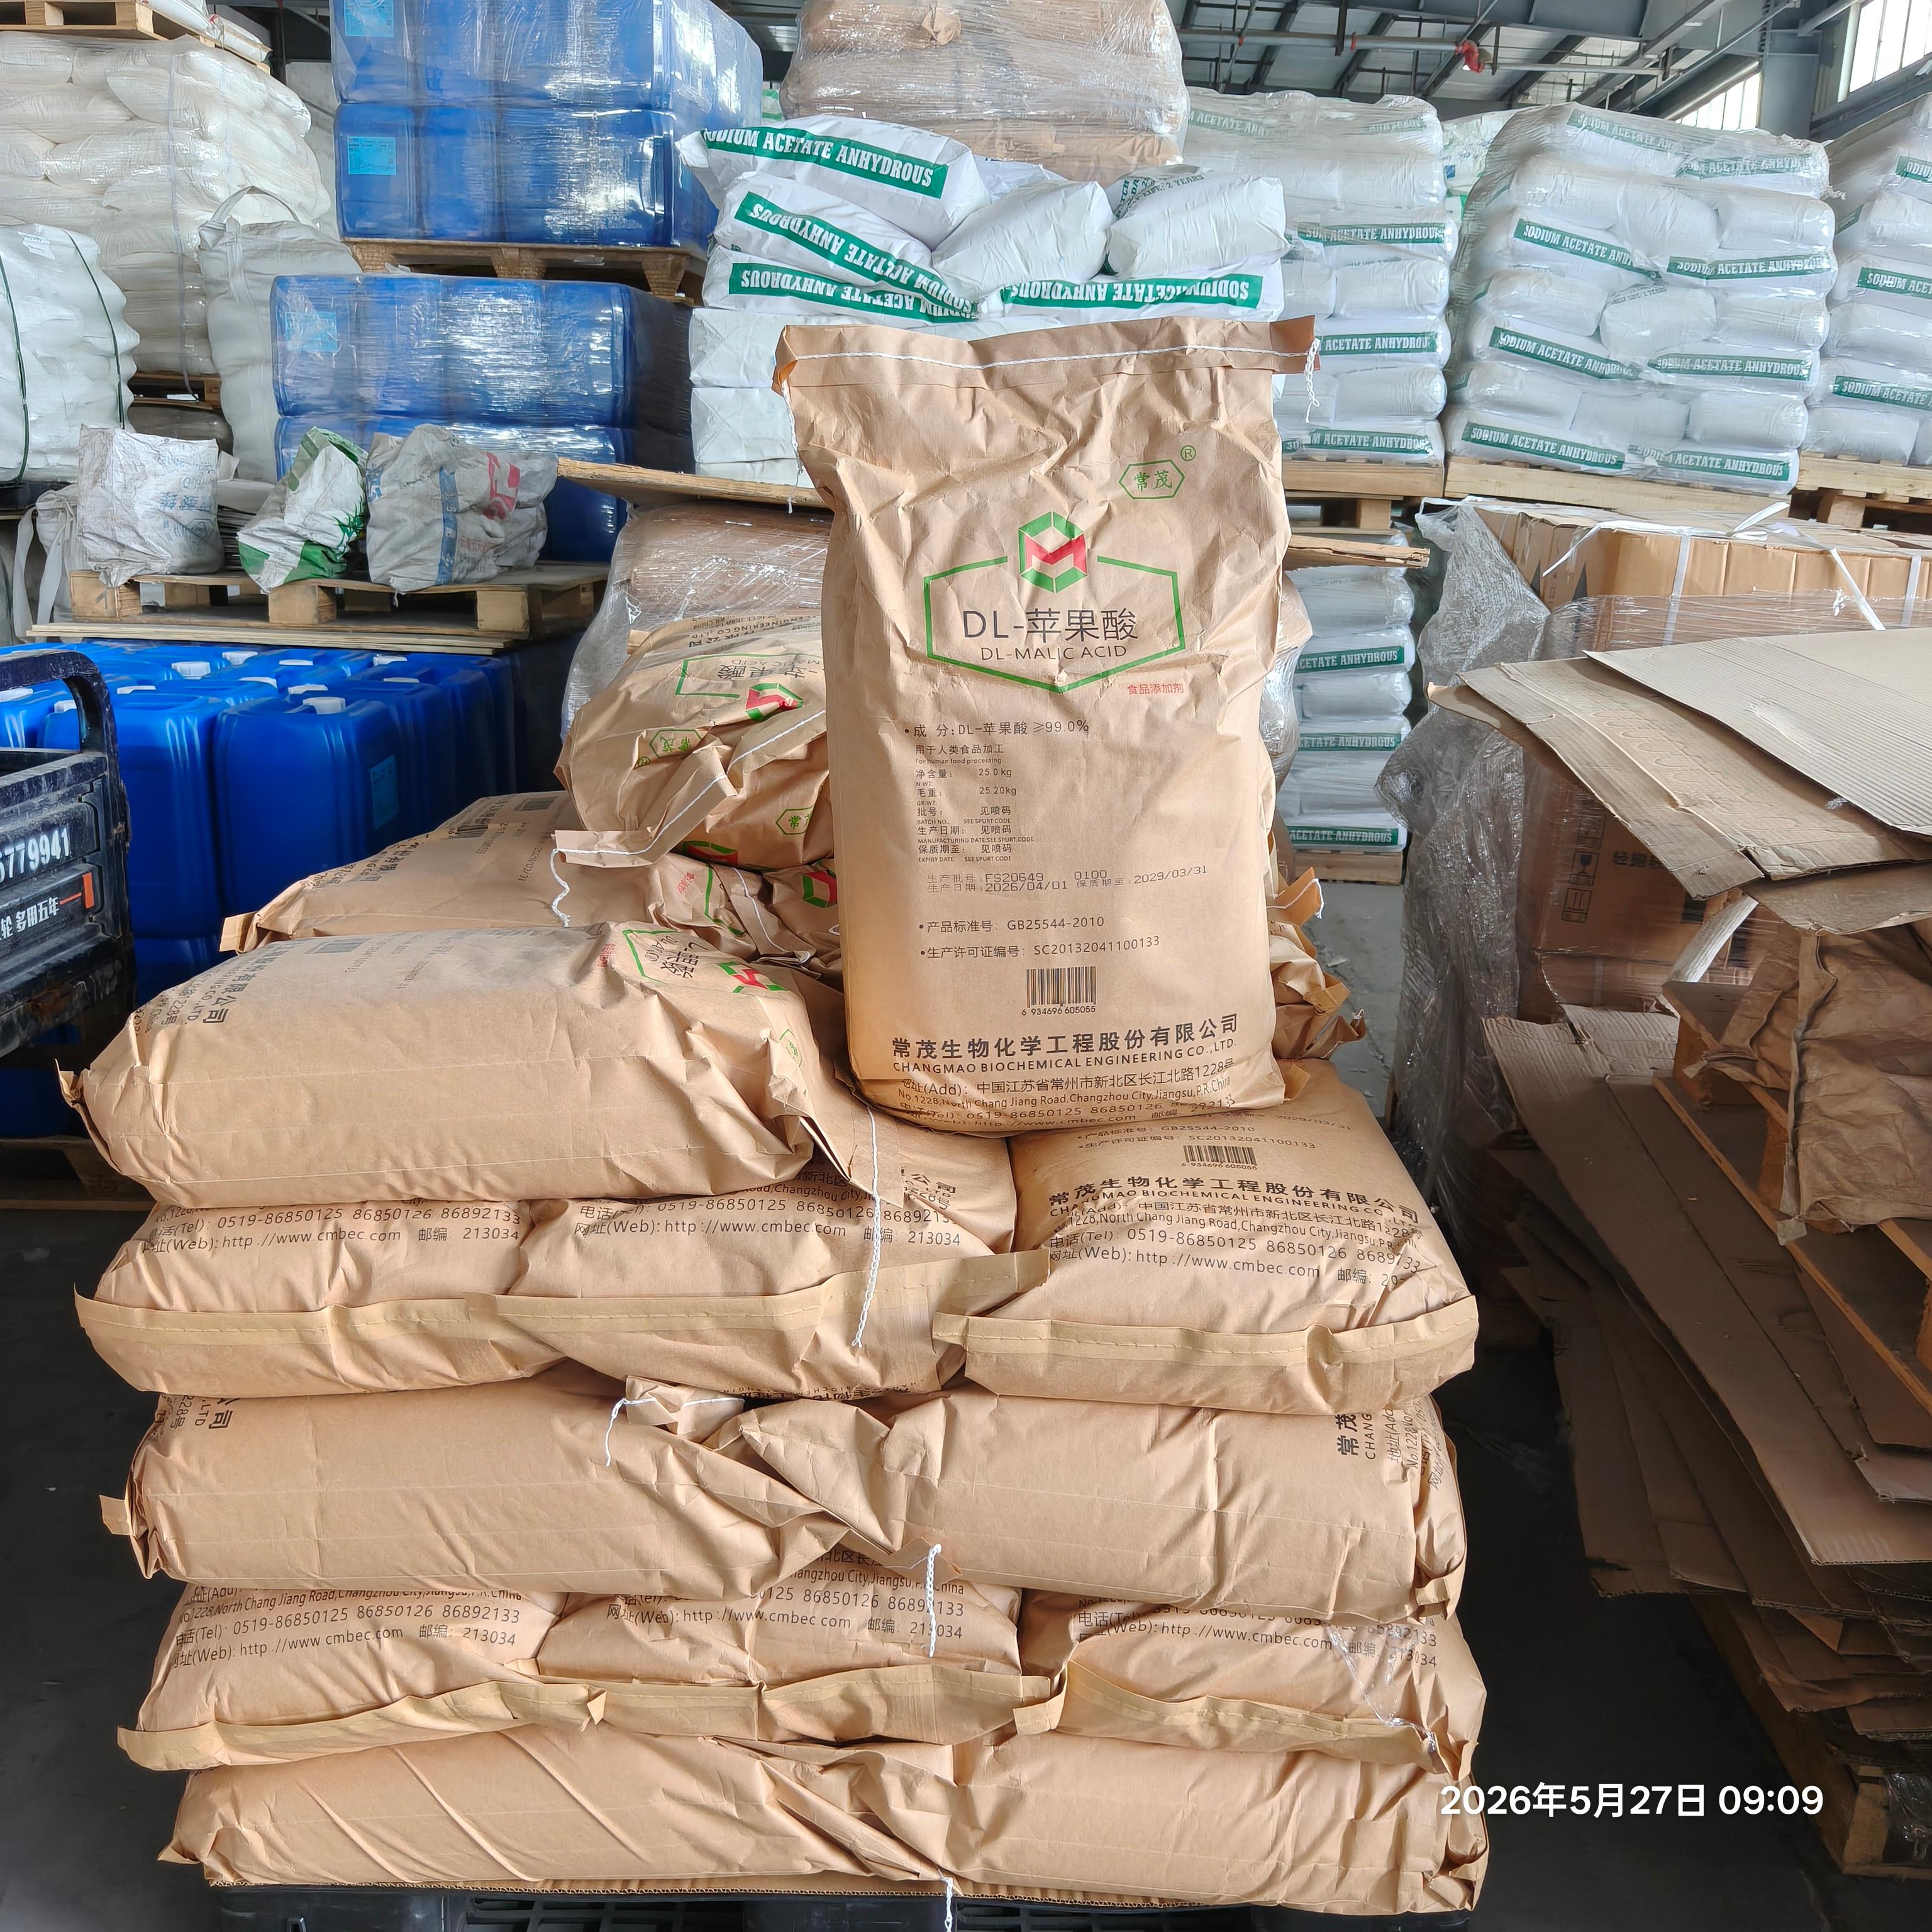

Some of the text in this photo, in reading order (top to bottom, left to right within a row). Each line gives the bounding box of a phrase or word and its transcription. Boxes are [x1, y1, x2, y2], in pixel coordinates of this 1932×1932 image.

[763, 133, 935, 188] ACETATE ANHYDROUS
[1523, 224, 1562, 245] SODIUM
[1562, 233, 1607, 258] ACETATE
[749, 203, 972, 314] ANHYDROUS ACETATE SODIUM
[1717, 260, 1765, 275] ACETATE
[741, 269, 835, 298] ANHYDROUS
[1010, 280, 1108, 302] ANHYDROUS
[1866, 271, 1932, 296] SODIUM ACET
[1325, 338, 1372, 352] ACETATE
[1498, 331, 1584, 368] SODIUM ACETATE
[1841, 379, 1928, 406] SODIUM ACETATE
[1323, 434, 1369, 447] ACETATE
[1470, 426, 1618, 466] SODIUM ACETATE ANHYDROUS
[1675, 452, 1723, 470] ACETATE
[1133, 469, 1173, 493] 常茂
[962, 608, 1139, 643] DL-苹果酸
[980, 643, 1128, 662] DL-MALIC ACID
[1340, 650, 1398, 665] ANHYDROUS
[1126, 682, 1185, 696] 食品添加剂
[915, 743, 1005, 755] 用于人类食品加工
[1298, 735, 1395, 749] CETATE ANHYDROUS
[967, 757, 1002, 765] processing
[1001, 768, 1012, 778] kg
[980, 806, 1011, 816] 见喷码
[980, 824, 1012, 835] 见喷码
[1289, 829, 1392, 843] ACETATE ANHYDROUS
[980, 843, 1012, 854] 见喷码
[1074, 870, 1108, 880] 0100
[1007, 916, 1105, 931] GB25544-2010
[1033, 935, 1160, 956] SC20132041100133
[1031, 1007, 1063, 1016] 934696
[1064, 1005, 1096, 1014] 605055
[892, 1012, 1239, 1060] 常茂生物化学工程股份有限公司
[892, 1061, 976, 1074] CHANGMAO
[980, 1058, 1082, 1072] BIOCHEMICAL
[1086, 1048, 1183, 1068] ENGINEERING
[974, 1098, 1007, 1111] Chang
[1009, 1096, 1037, 1108] Jiang
[1040, 1092, 1128, 1106] Road,Changzhou
[1091, 1102, 1162, 1114] 86850126
[1188, 1135, 1316, 1149] SC20132041100133
[657, 1197, 874, 1220] 0519-86850125 86850126
[1048, 1175, 1419, 1224] 常茂生物化学工程股份有限公司
[1142, 1189, 1250, 1201] BIOCHEMICAL
[1254, 1194, 1359, 1213] ENGINEERING
[218, 1208, 343, 1230] 0519-86850125
[352, 1208, 433, 1221] 86850126
[440, 1208, 521, 1225] 86892133
[1136, 1211, 1306, 1236] Chang Jiang Road,Changzhou
[222, 1235, 253, 1250] http
[462, 1227, 519, 1241] 213034
[665, 1220, 696, 1237] http
[908, 1231, 961, 1246] 213034
[1127, 1228, 1257, 1250] 0519-86850125
[1266, 1240, 1347, 1260] 86850126
[1136, 1249, 1168, 1267] http
[245, 1592, 306, 1611] Chang Jiang
[802, 1589, 964, 1617] 86850126 8689133
[233, 1607, 348, 1636] 0519-86850125
[357, 1604, 433, 1619] 86850126
[441, 1604, 520, 1624] 86892133
[683, 1607, 713, 1625] http
[1162, 1622, 1191, 1637] http
[240, 1643, 268, 1658] http
[462, 1626, 516, 1646] 213034
